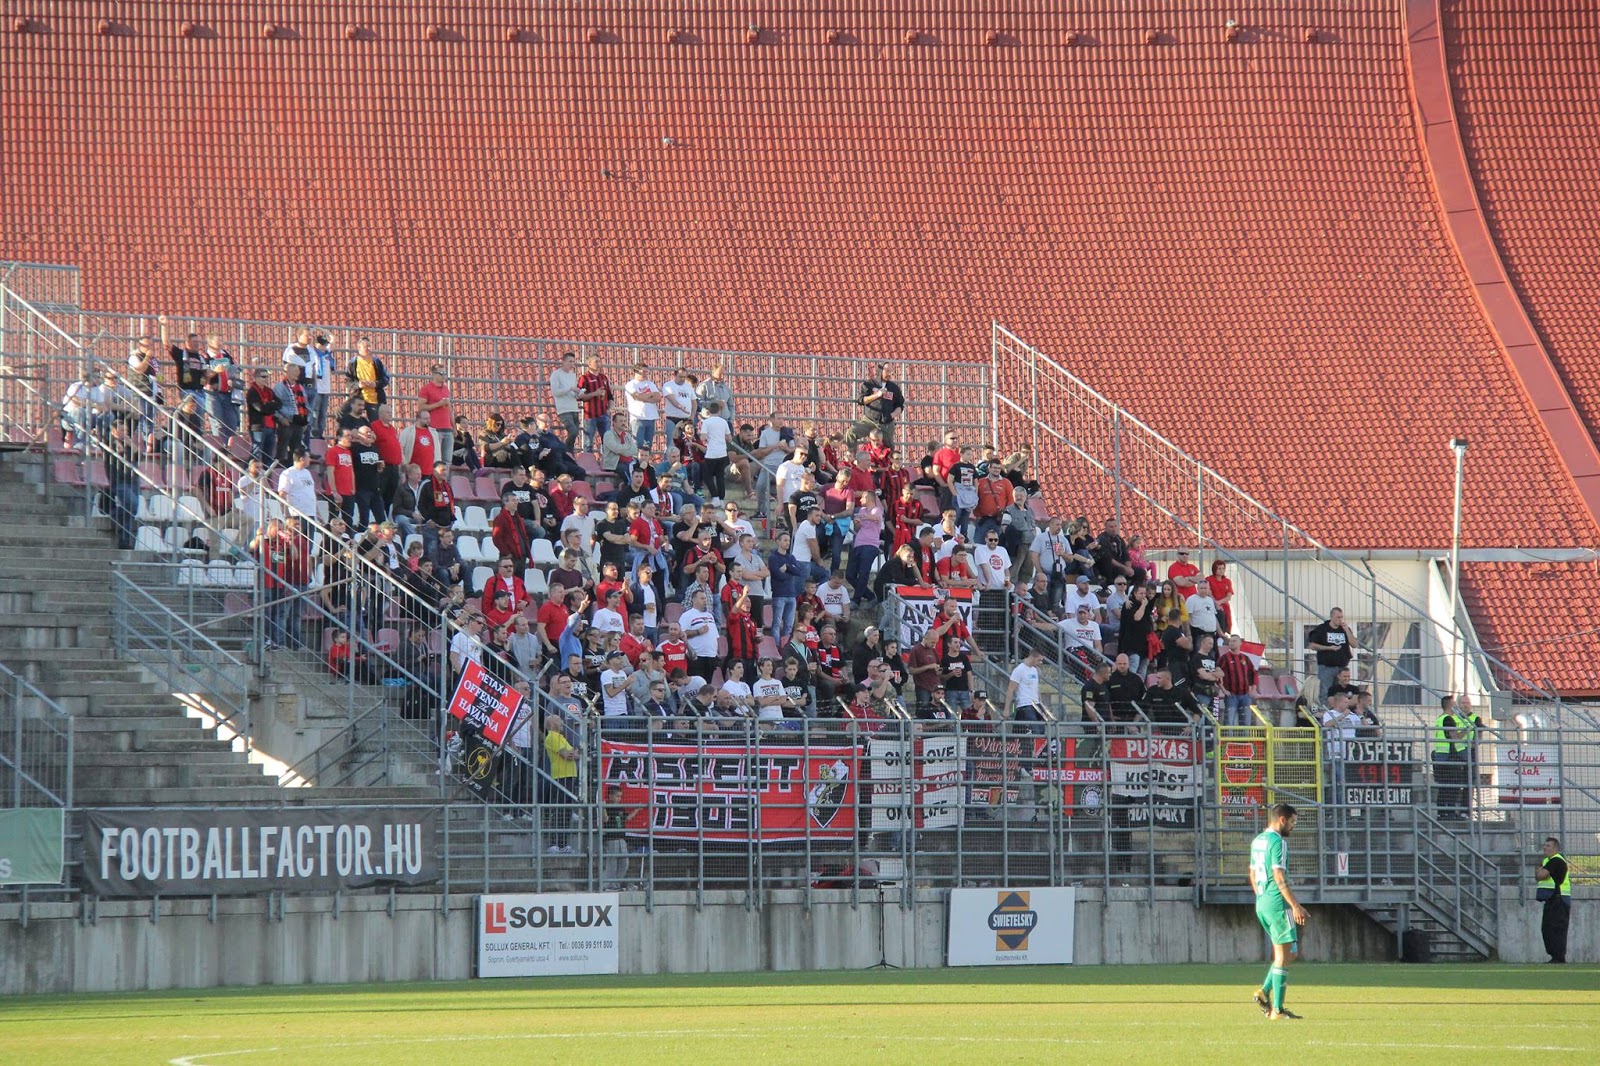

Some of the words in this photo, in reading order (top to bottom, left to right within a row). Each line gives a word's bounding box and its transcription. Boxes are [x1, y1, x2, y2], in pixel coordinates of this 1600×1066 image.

[903, 604, 971, 625] AWY
[477, 670, 509, 697] METAXA
[463, 680, 510, 718] OFFENDER
[458, 698, 499, 733] HAVANNA
[1221, 796, 1248, 804] OYALTY
[102, 823, 422, 881] FOOTBALLFACTOR.HU
[509, 905, 613, 929] SOLLUX
[992, 913, 1034, 928] SWIETELSKY
[485, 943, 509, 951] SOLLUX
[510, 942, 538, 951] GENERAL
[585, 940, 592, 949] 99
[593, 940, 602, 949] 511
